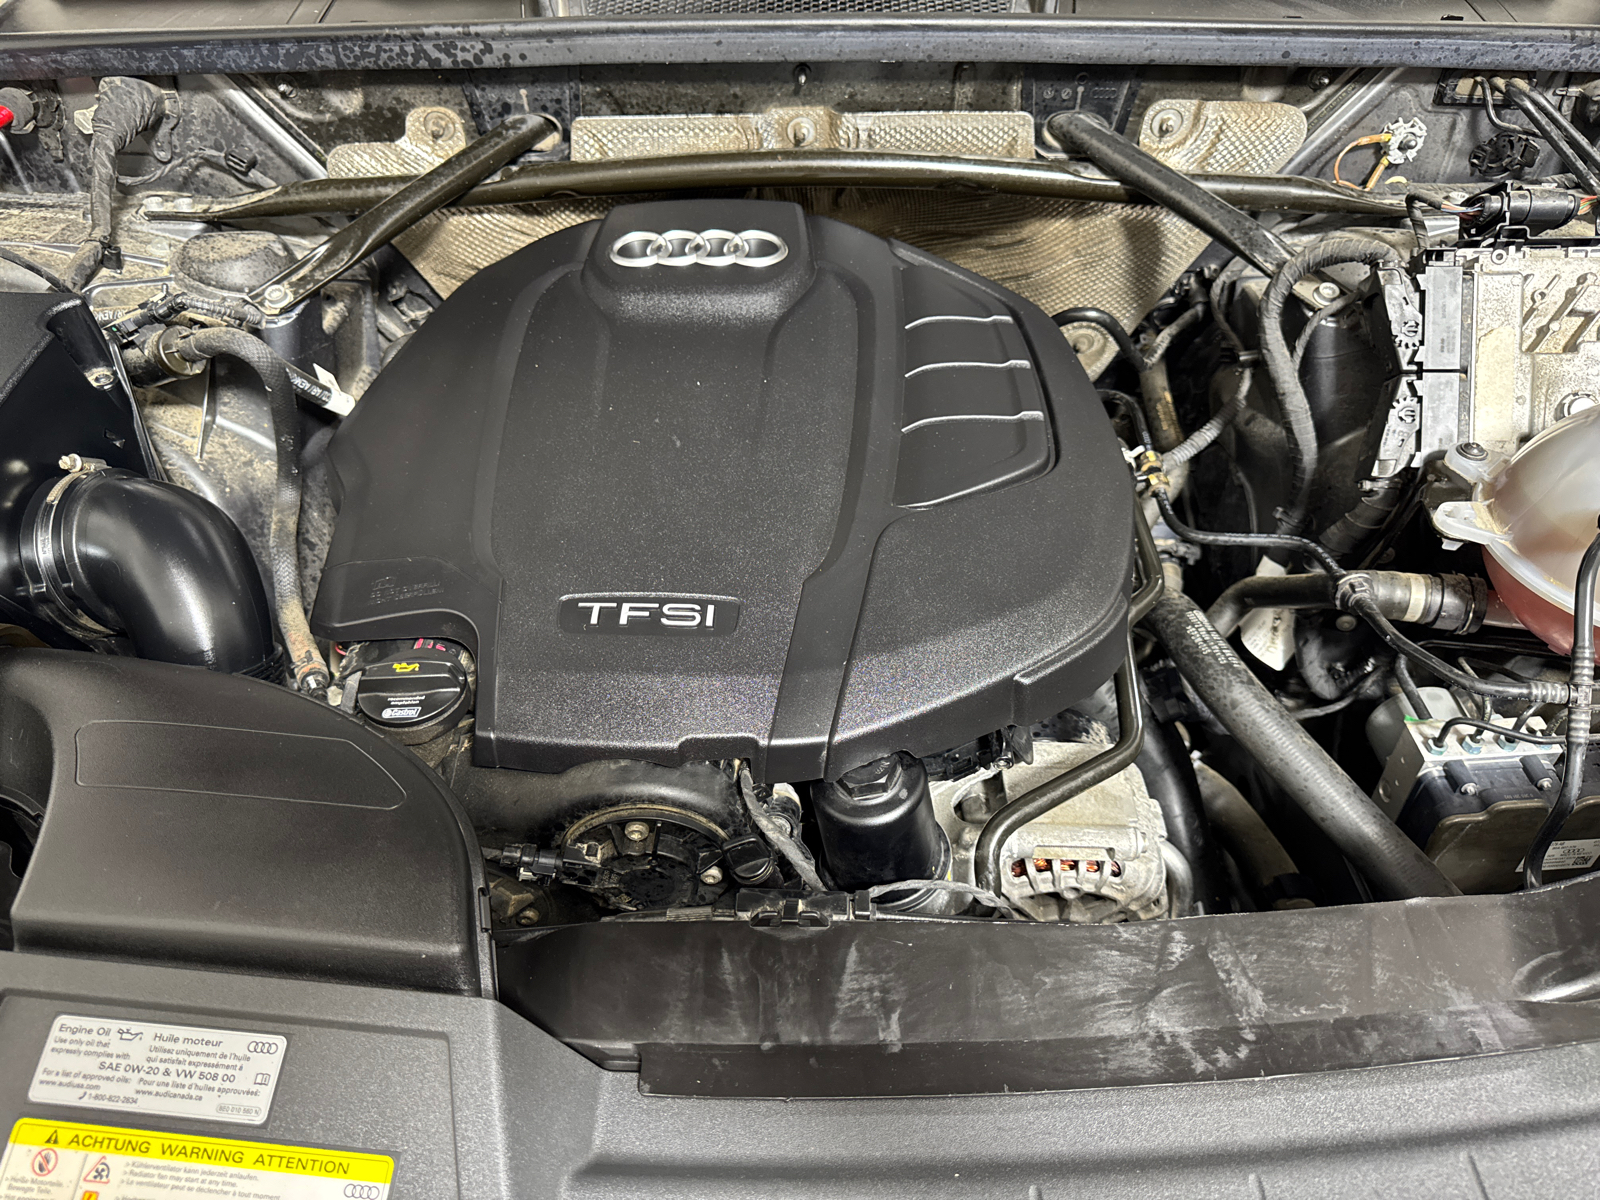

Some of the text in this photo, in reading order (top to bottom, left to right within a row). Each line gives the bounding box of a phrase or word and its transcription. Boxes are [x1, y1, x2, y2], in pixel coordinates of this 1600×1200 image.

[577, 602, 715, 627] TFSI
[59, 1023, 112, 1037] Engine Oil
[53, 1036, 111, 1049] Use only oil that
[153, 1032, 224, 1048] Huile moteur
[50, 1046, 131, 1060] expressly complies with
[149, 1044, 174, 1055] Utilisez
[175, 1048, 218, 1060] uniquement
[145, 1055, 158, 1064] qui
[158, 1056, 187, 1066] satisfait
[187, 1059, 237, 1071] expressément
[41, 1067, 55, 1076] For
[61, 1068, 72, 1077] list
[82, 1072, 115, 1083] approved
[116, 1075, 132, 1084] oils:
[98, 1061, 236, 1083] SAE 0W-20 & VW 508 00
[39, 1079, 101, 1091] www.audiusa.com
[138, 1077, 156, 1087] Pour
[156, 1080, 170, 1088] une
[170, 1081, 186, 1090] liste
[135, 1088, 203, 1102] www.audicanada.ca
[68, 1133, 350, 1175] ACHTUNG WARNING ATTENTION
[129, 1169, 156, 1180] Radiator
[157, 1172, 168, 1181] fan
[169, 1174, 184, 1183] may
[184, 1176, 200, 1184] start
[208, 1179, 221, 1188] any
[221, 1180, 238, 1188] time.
[183, 1166, 200, 1175] kann
[200, 1168, 229, 1178] jederzeit
[229, 1171, 259, 1182] anlaufen.
[170, 1183, 187, 1192] peut
[238, 1190, 252, 1199] tout
